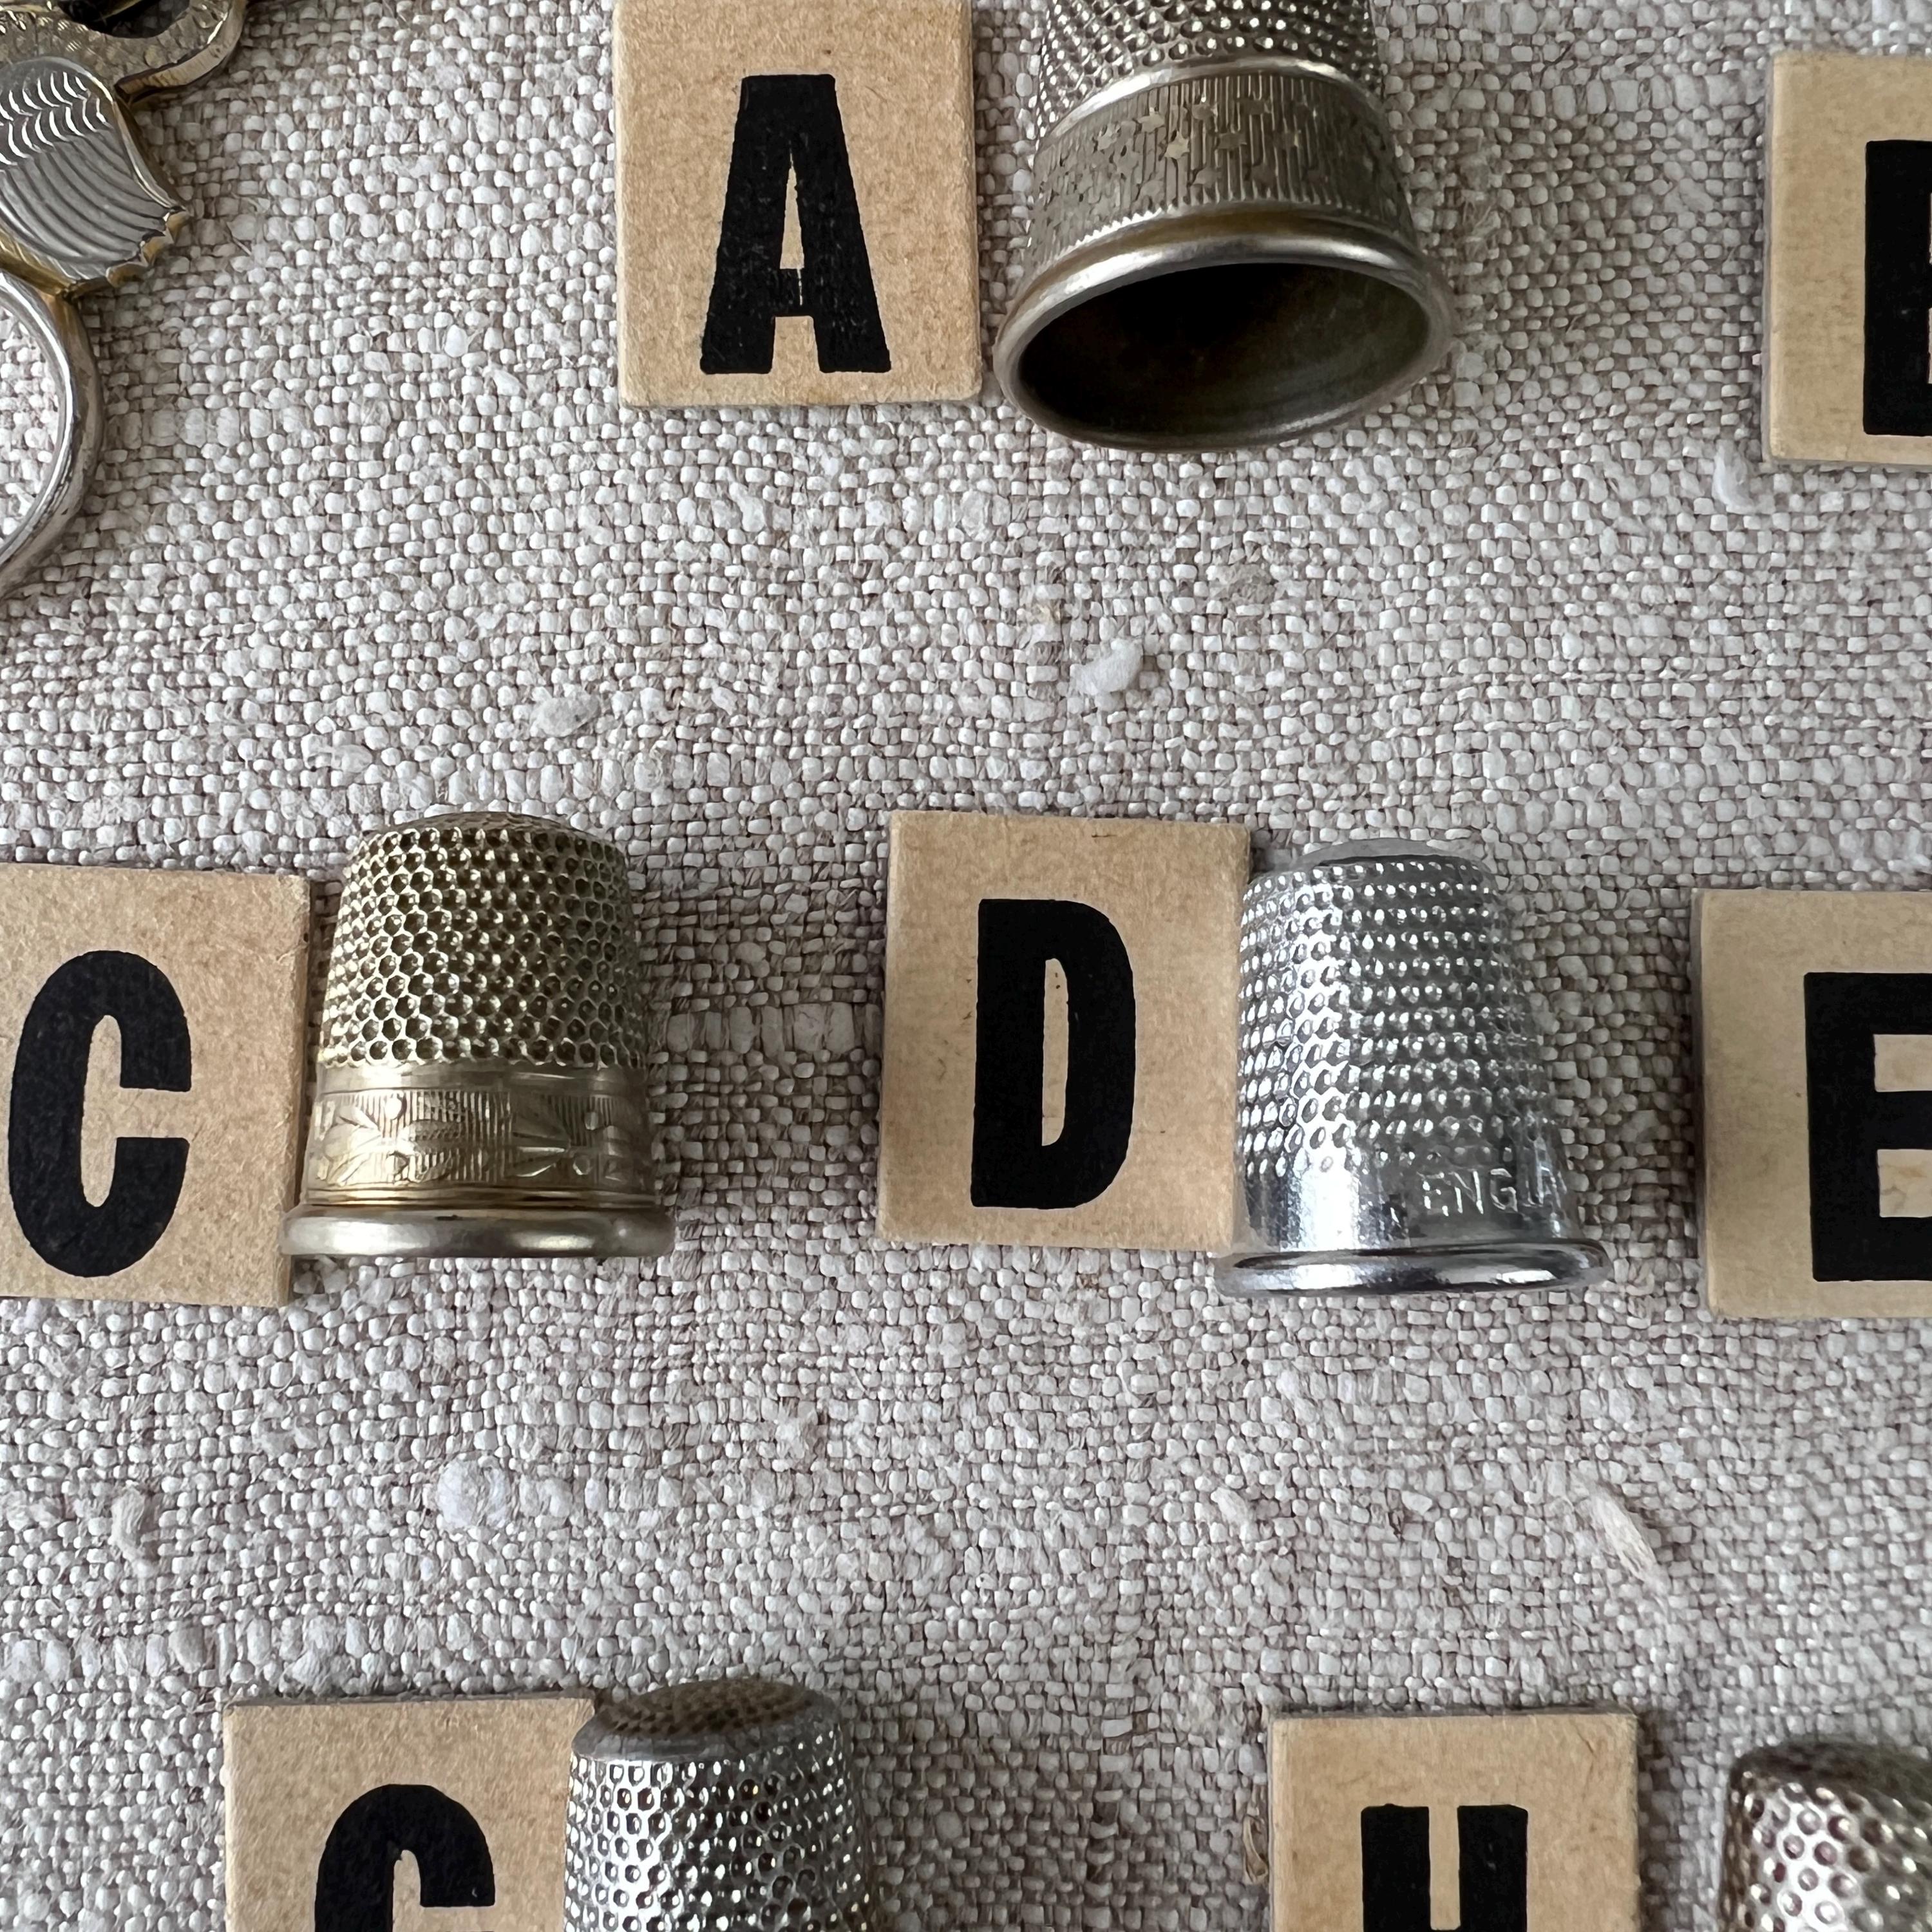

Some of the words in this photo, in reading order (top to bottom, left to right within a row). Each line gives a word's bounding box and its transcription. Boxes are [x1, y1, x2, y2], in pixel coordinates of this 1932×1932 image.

[701, 75, 889, 373] A
[9, 951, 191, 1277] C
[971, 900, 1135, 1209] D
[1804, 972, 1932, 1281] E
